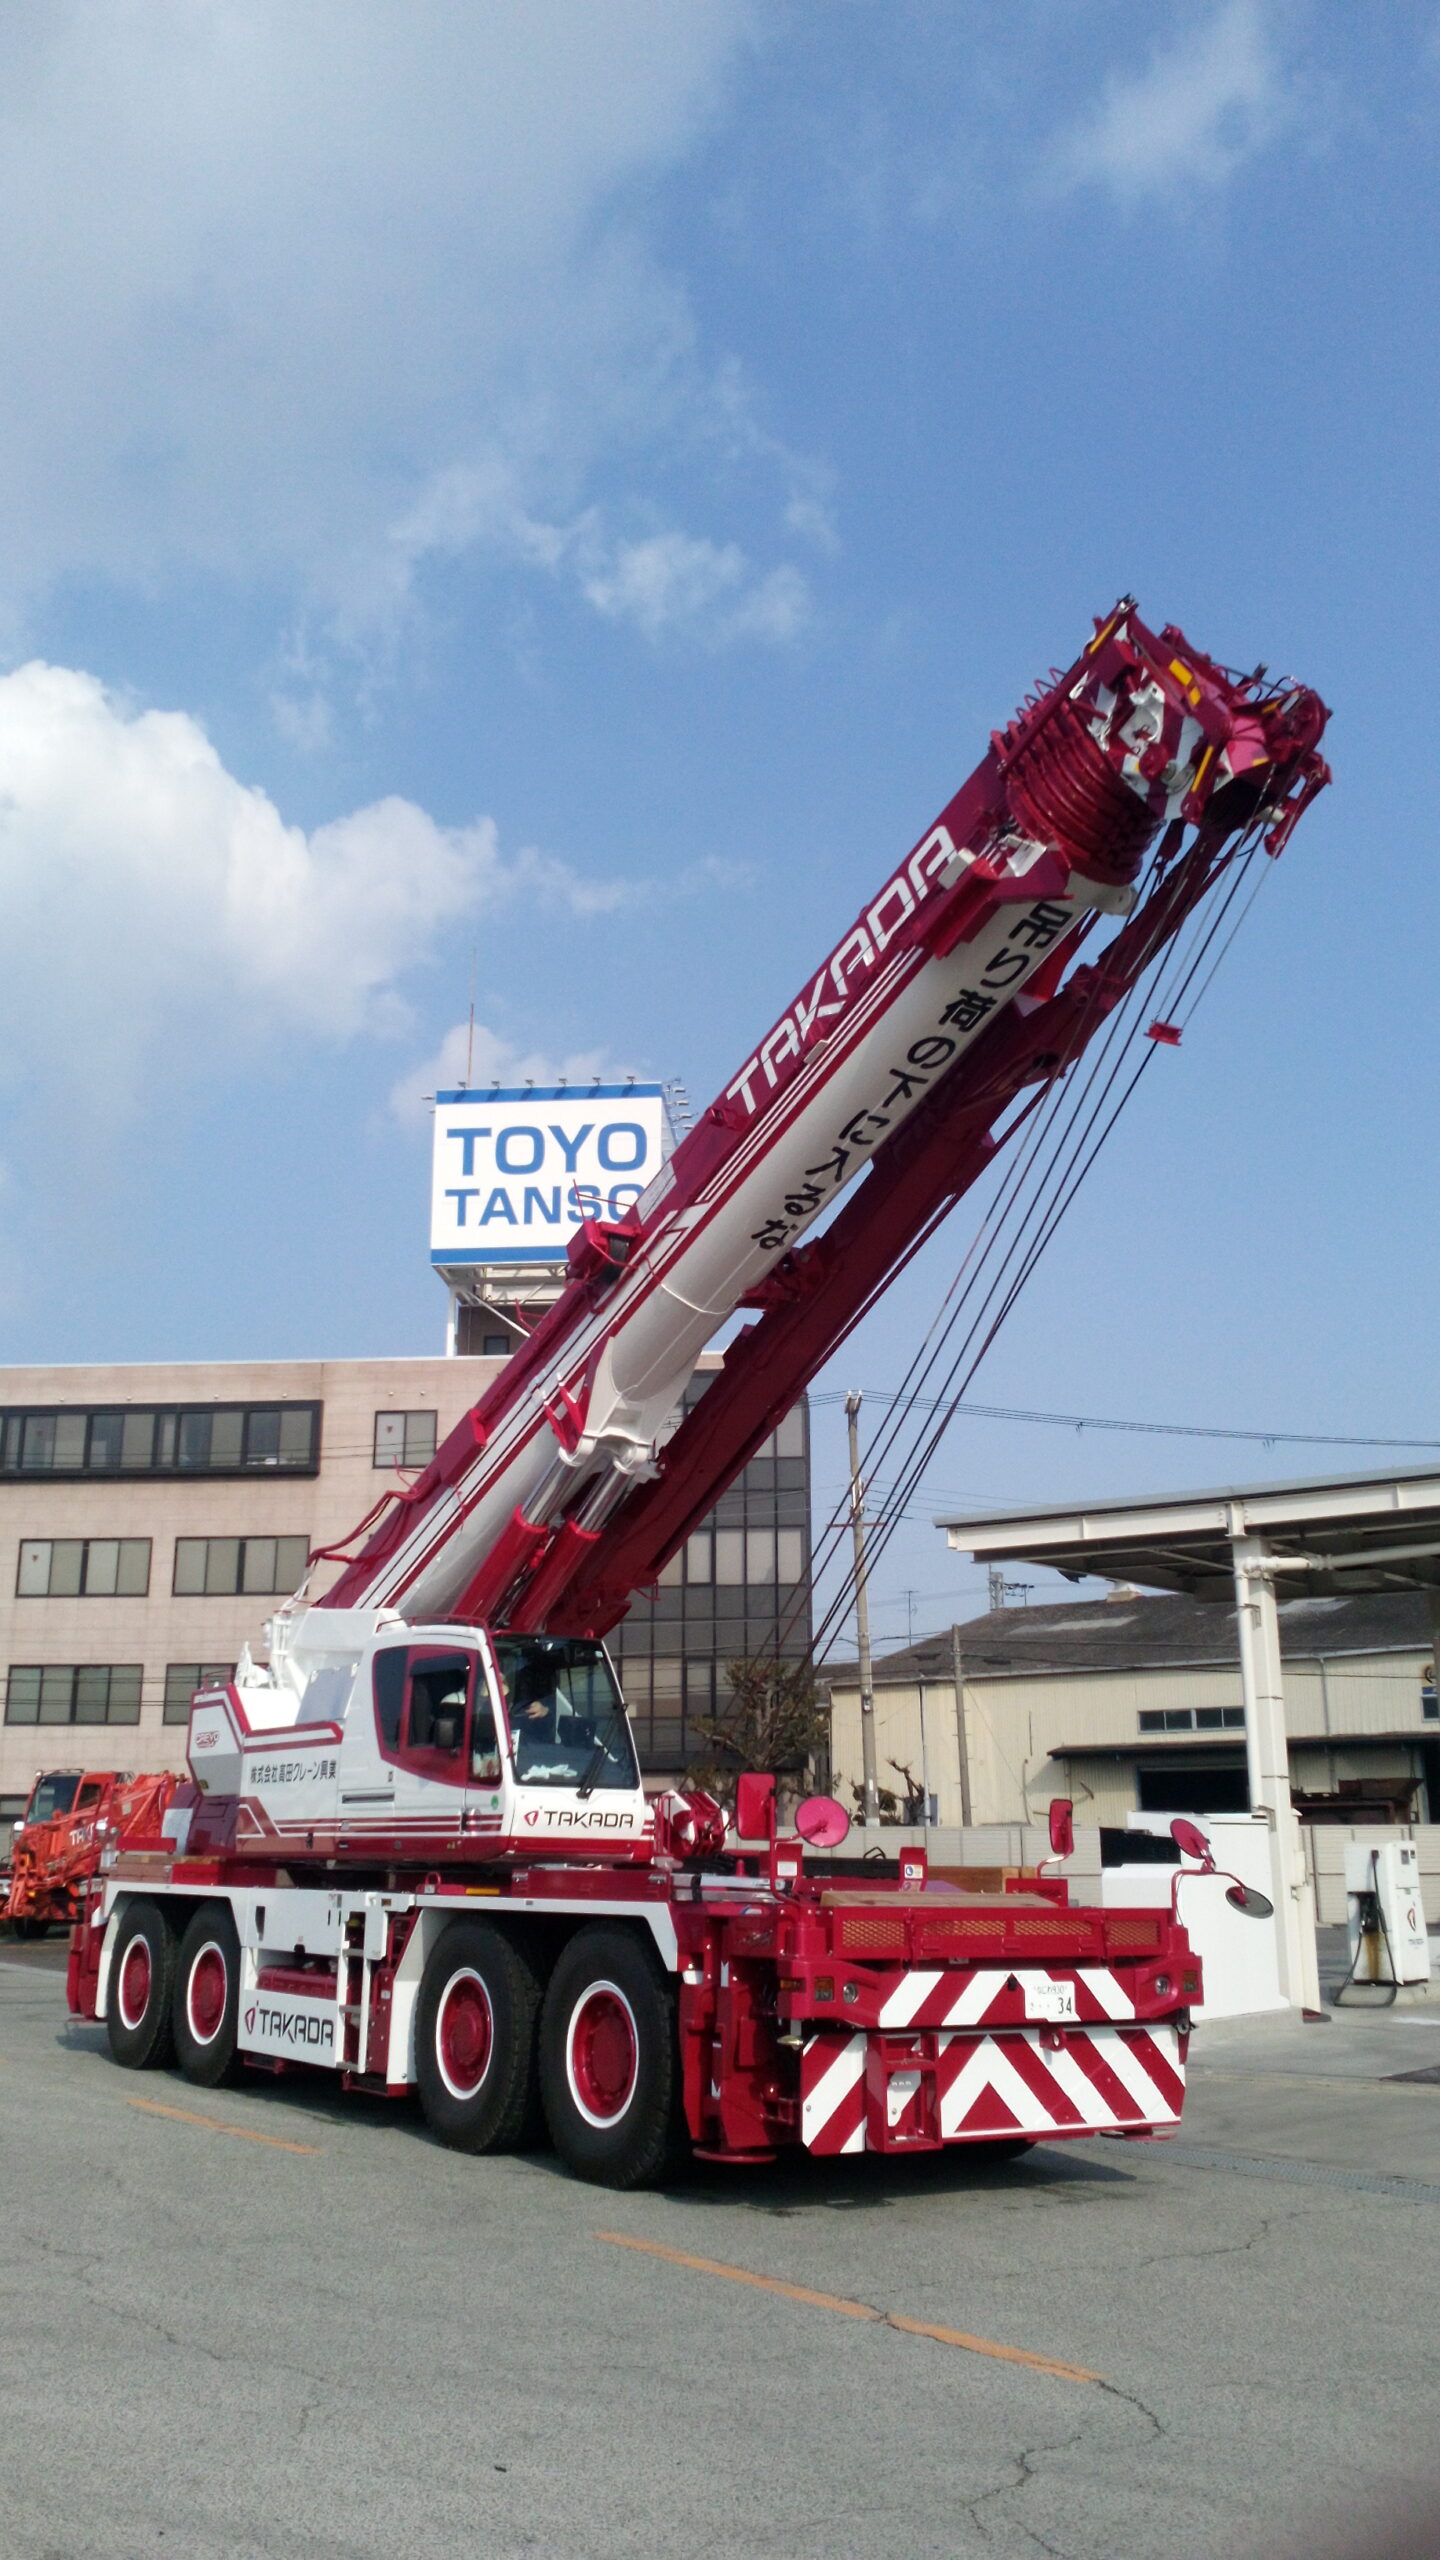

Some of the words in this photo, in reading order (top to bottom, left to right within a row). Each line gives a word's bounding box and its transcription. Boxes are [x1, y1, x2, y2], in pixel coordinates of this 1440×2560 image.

[726, 825, 957, 1116] TAKADA
[446, 1122, 648, 1176] TOYO
[544, 1811, 634, 1828] TAKADA
[259, 2008, 334, 2047] TAKADA
